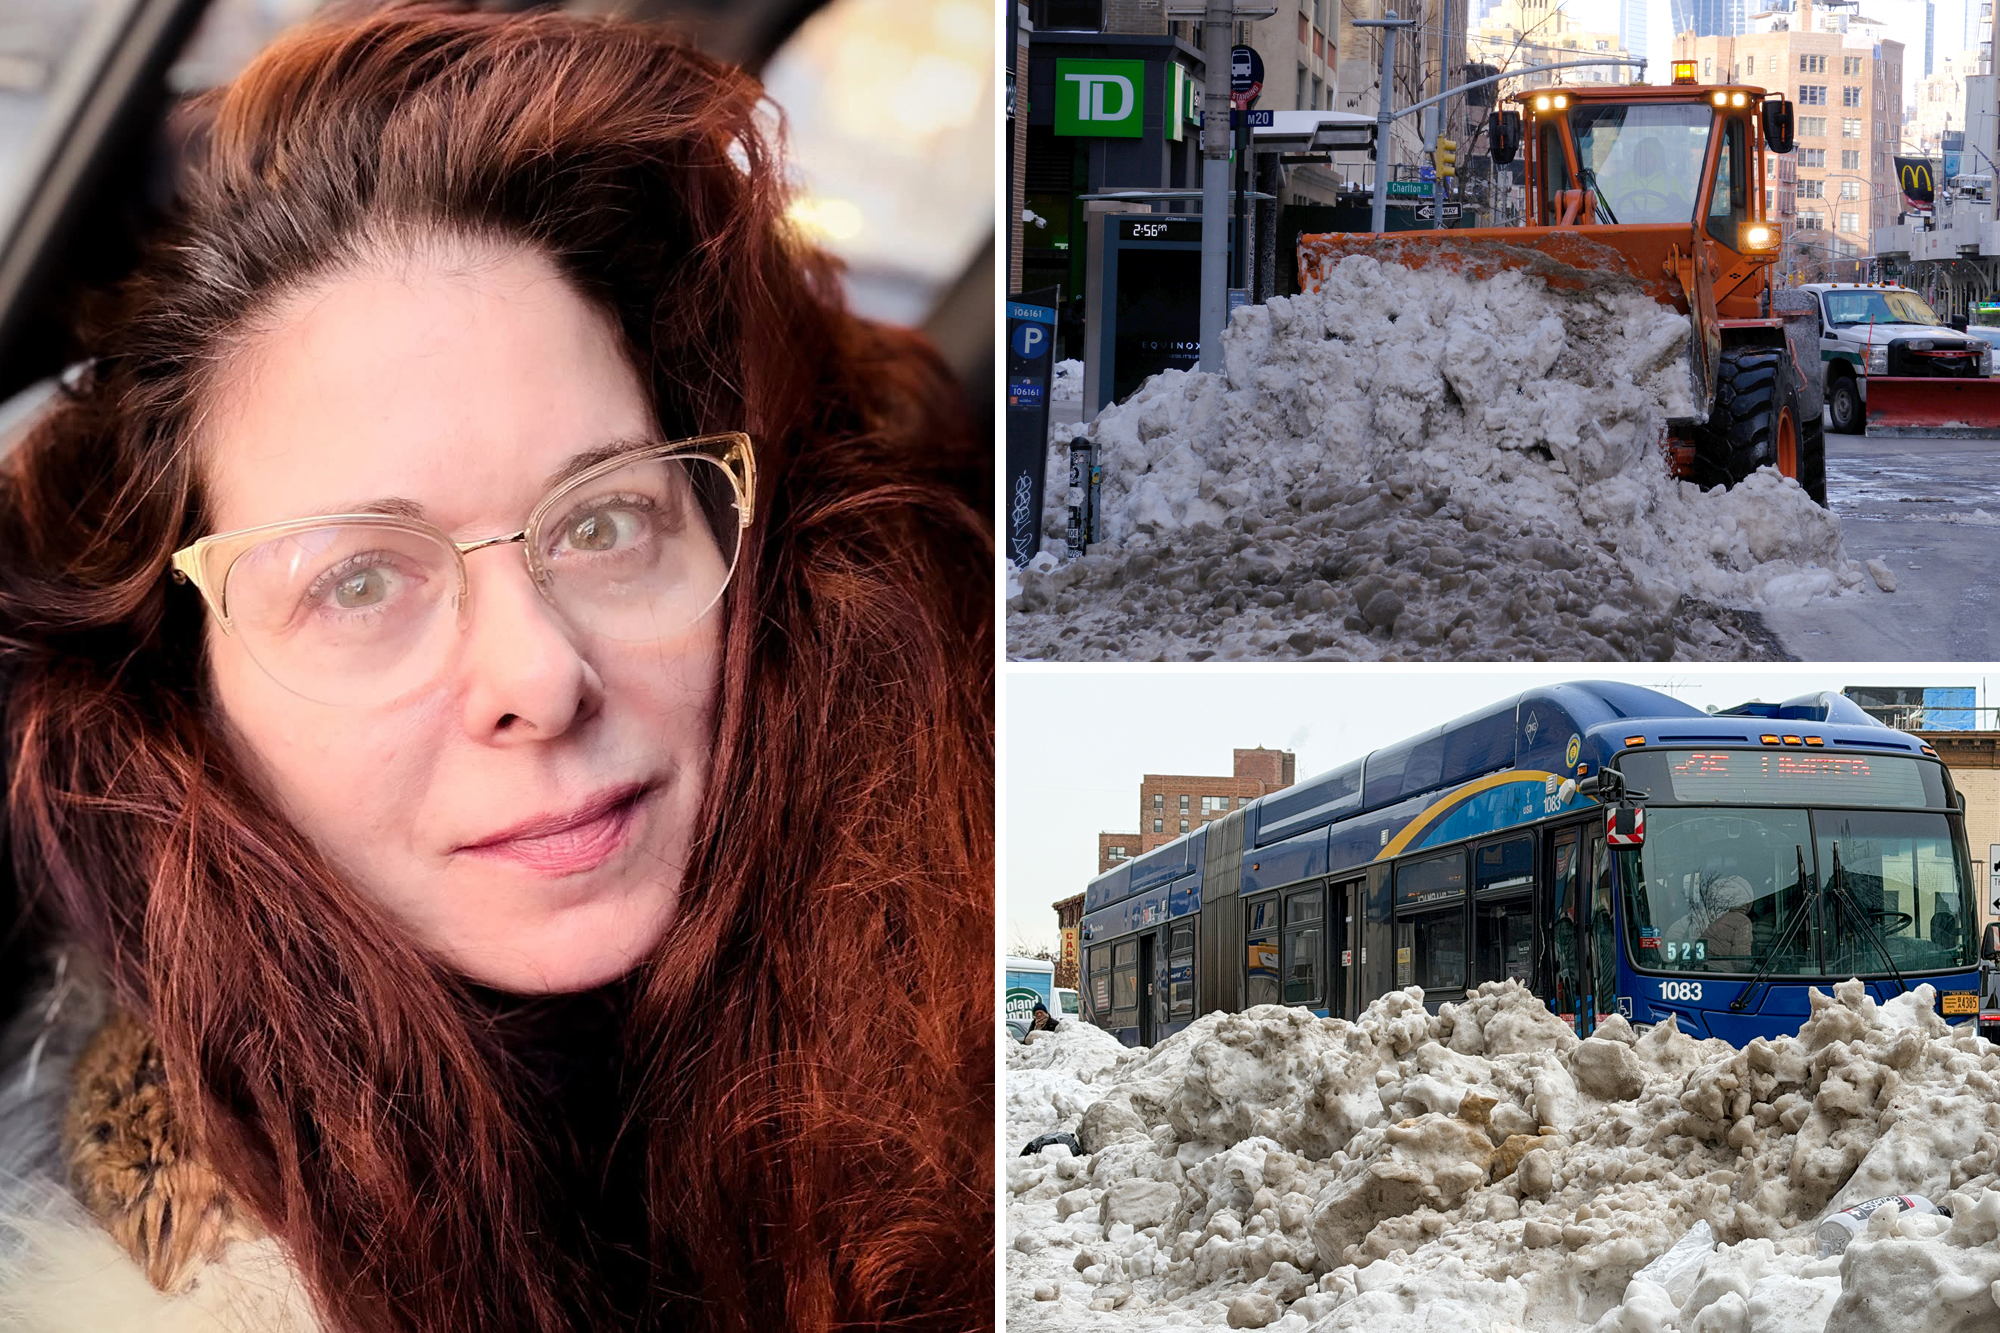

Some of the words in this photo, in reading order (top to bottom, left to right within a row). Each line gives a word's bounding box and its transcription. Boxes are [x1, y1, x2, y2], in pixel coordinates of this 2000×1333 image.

[1064, 73, 1135, 122] TD
[1231, 84, 1260, 100] STANDING
[1247, 112, 1270, 125] M20
[1392, 183, 1421, 193] Charlton
[1013, 308, 1042, 318] 106161
[1024, 327, 1043, 354] P
[1013, 387, 1040, 396] 106161
[1522, 805, 1533, 814] USB
[1543, 794, 1561, 814] 1083
[1658, 981, 1703, 1001] 1083
